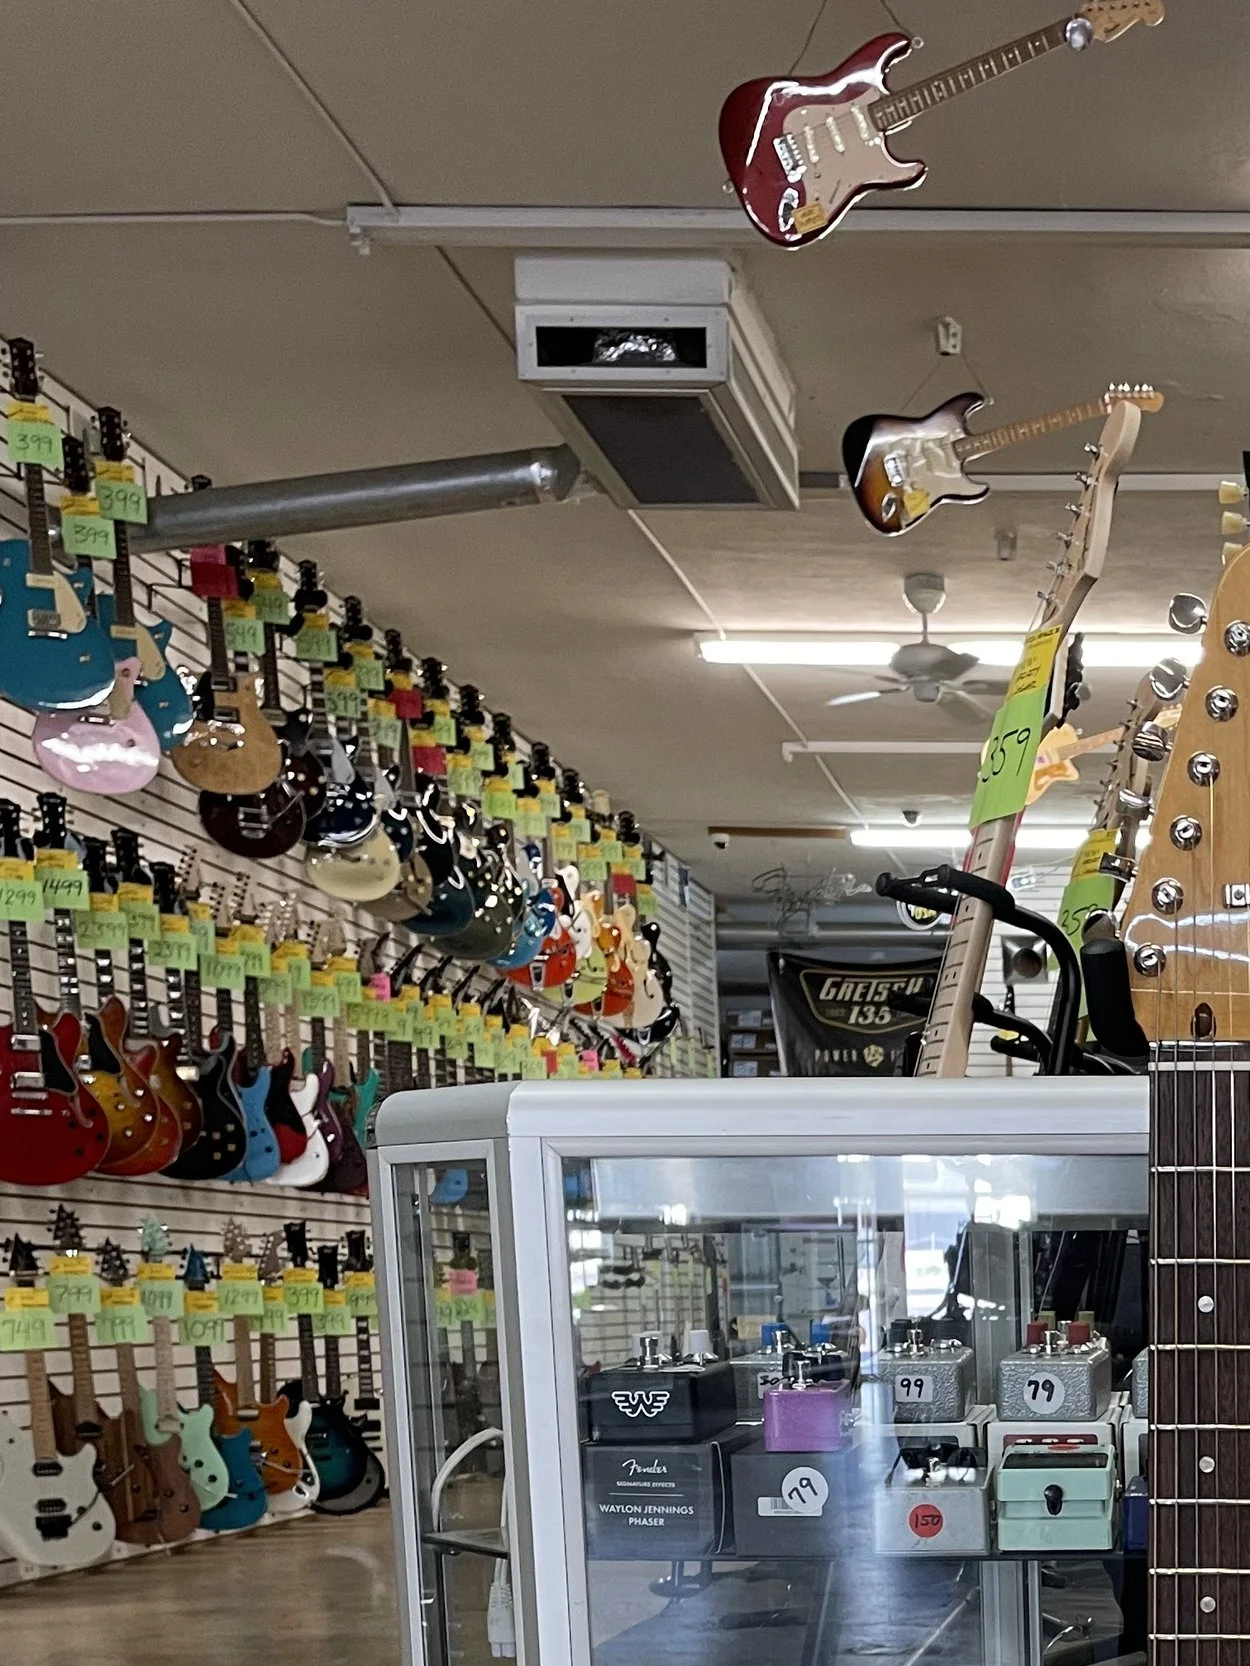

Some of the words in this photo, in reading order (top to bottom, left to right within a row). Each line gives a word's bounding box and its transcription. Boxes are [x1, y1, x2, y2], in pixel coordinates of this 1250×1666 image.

[15, 432, 53, 453] 399
[42, 878, 84, 898] 1499
[287, 1286, 320, 1308] 399
[2, 1317, 46, 1344] 749
[183, 1317, 226, 1342] 1099
[899, 1377, 925, 1398] 99
[1026, 1378, 1056, 1402] 79
[621, 1458, 668, 1476] Fender
[787, 1476, 818, 1504] 79
[599, 1504, 642, 1514] WAYLON
[643, 1505, 694, 1515] JENNINGS
[628, 1517, 665, 1527] PHASER
[914, 1514, 941, 1528] 150
